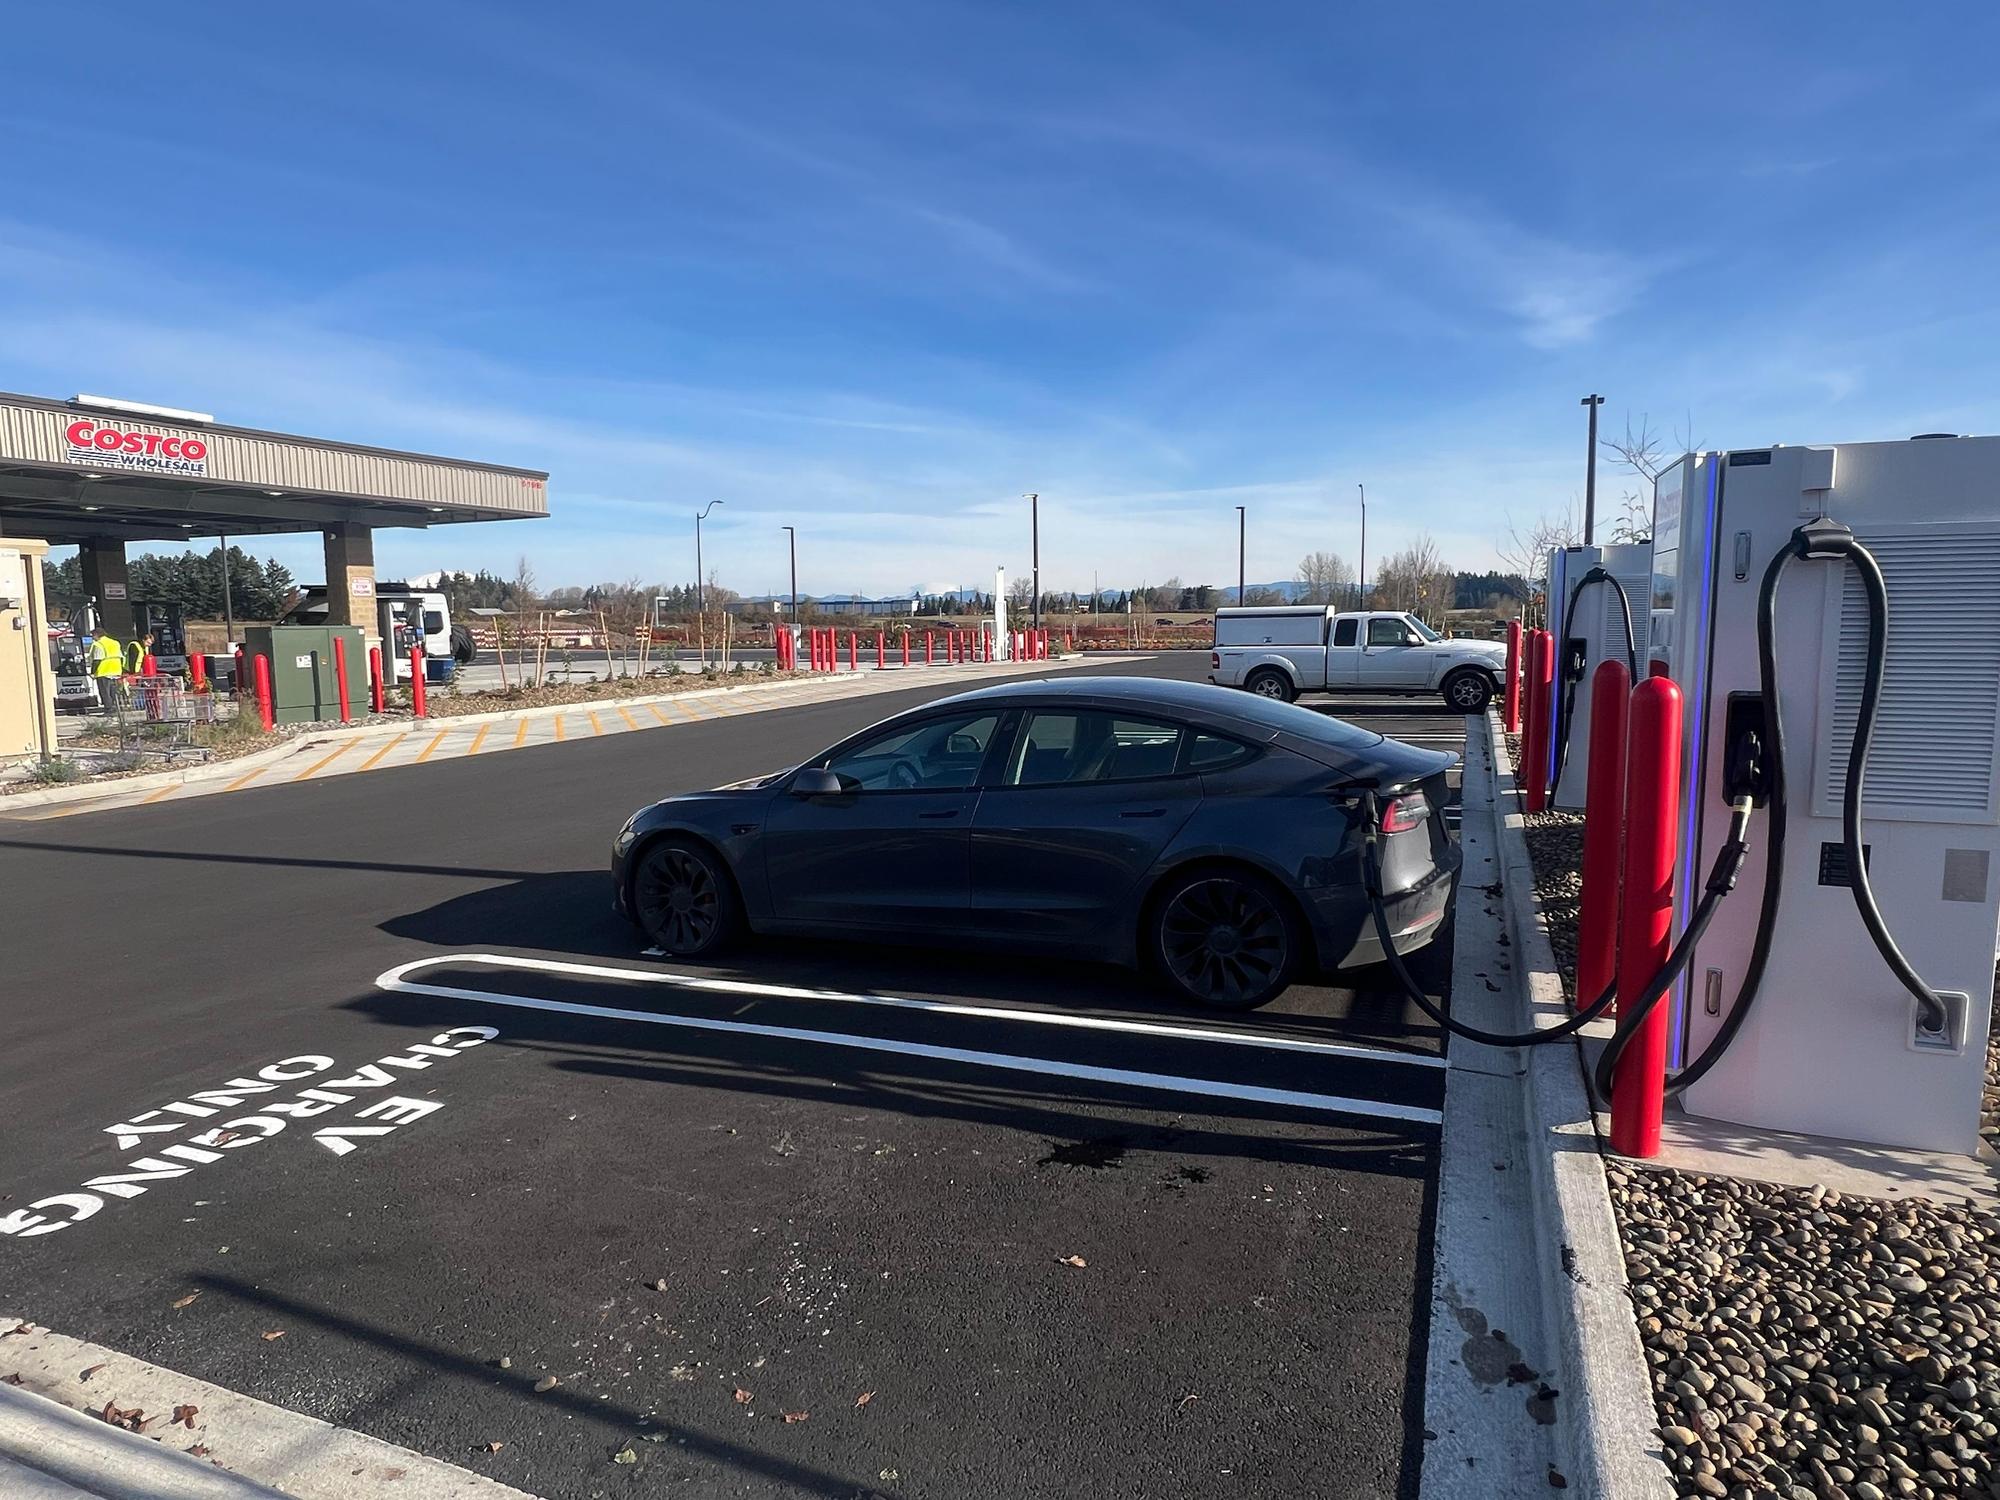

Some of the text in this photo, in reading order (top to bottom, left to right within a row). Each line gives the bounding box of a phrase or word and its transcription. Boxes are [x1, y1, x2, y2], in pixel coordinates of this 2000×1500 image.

[66, 421, 207, 460] COSTCO
[120, 454, 205, 473] WHOLESALE
[58, 687, 91, 695] ASOLINE
[103, 1054, 335, 1151] ONLY
[312, 1095, 446, 1157] EV
[0, 1025, 500, 1237] CHARGING
